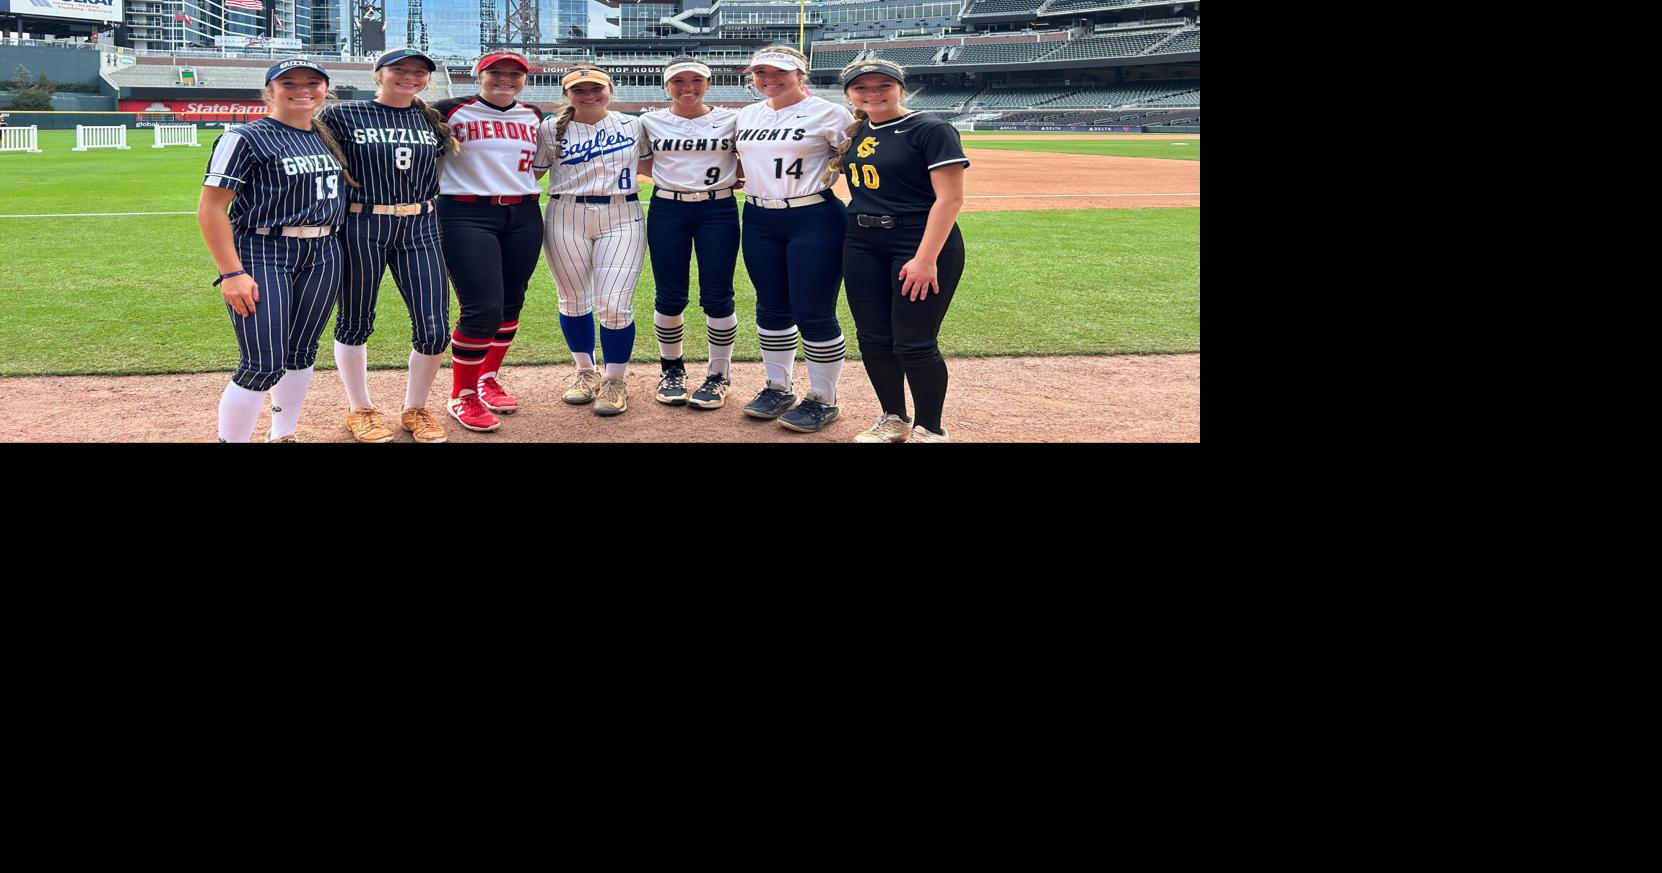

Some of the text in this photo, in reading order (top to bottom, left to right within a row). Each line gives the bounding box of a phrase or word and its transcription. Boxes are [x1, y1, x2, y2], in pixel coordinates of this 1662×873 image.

[353, 128, 438, 146] GRIZZLIES
[453, 120, 538, 145] CHEROKE
[559, 128, 636, 165] Eagles
[652, 138, 730, 151] KNIGHTS
[281, 154, 342, 176] GRIZZL
[395, 147, 412, 170] 8
[773, 157, 803, 180] 14
[315, 175, 338, 200] 19
[618, 167, 632, 190] 8
[704, 166, 721, 186] 9
[849, 163, 880, 189] 10
